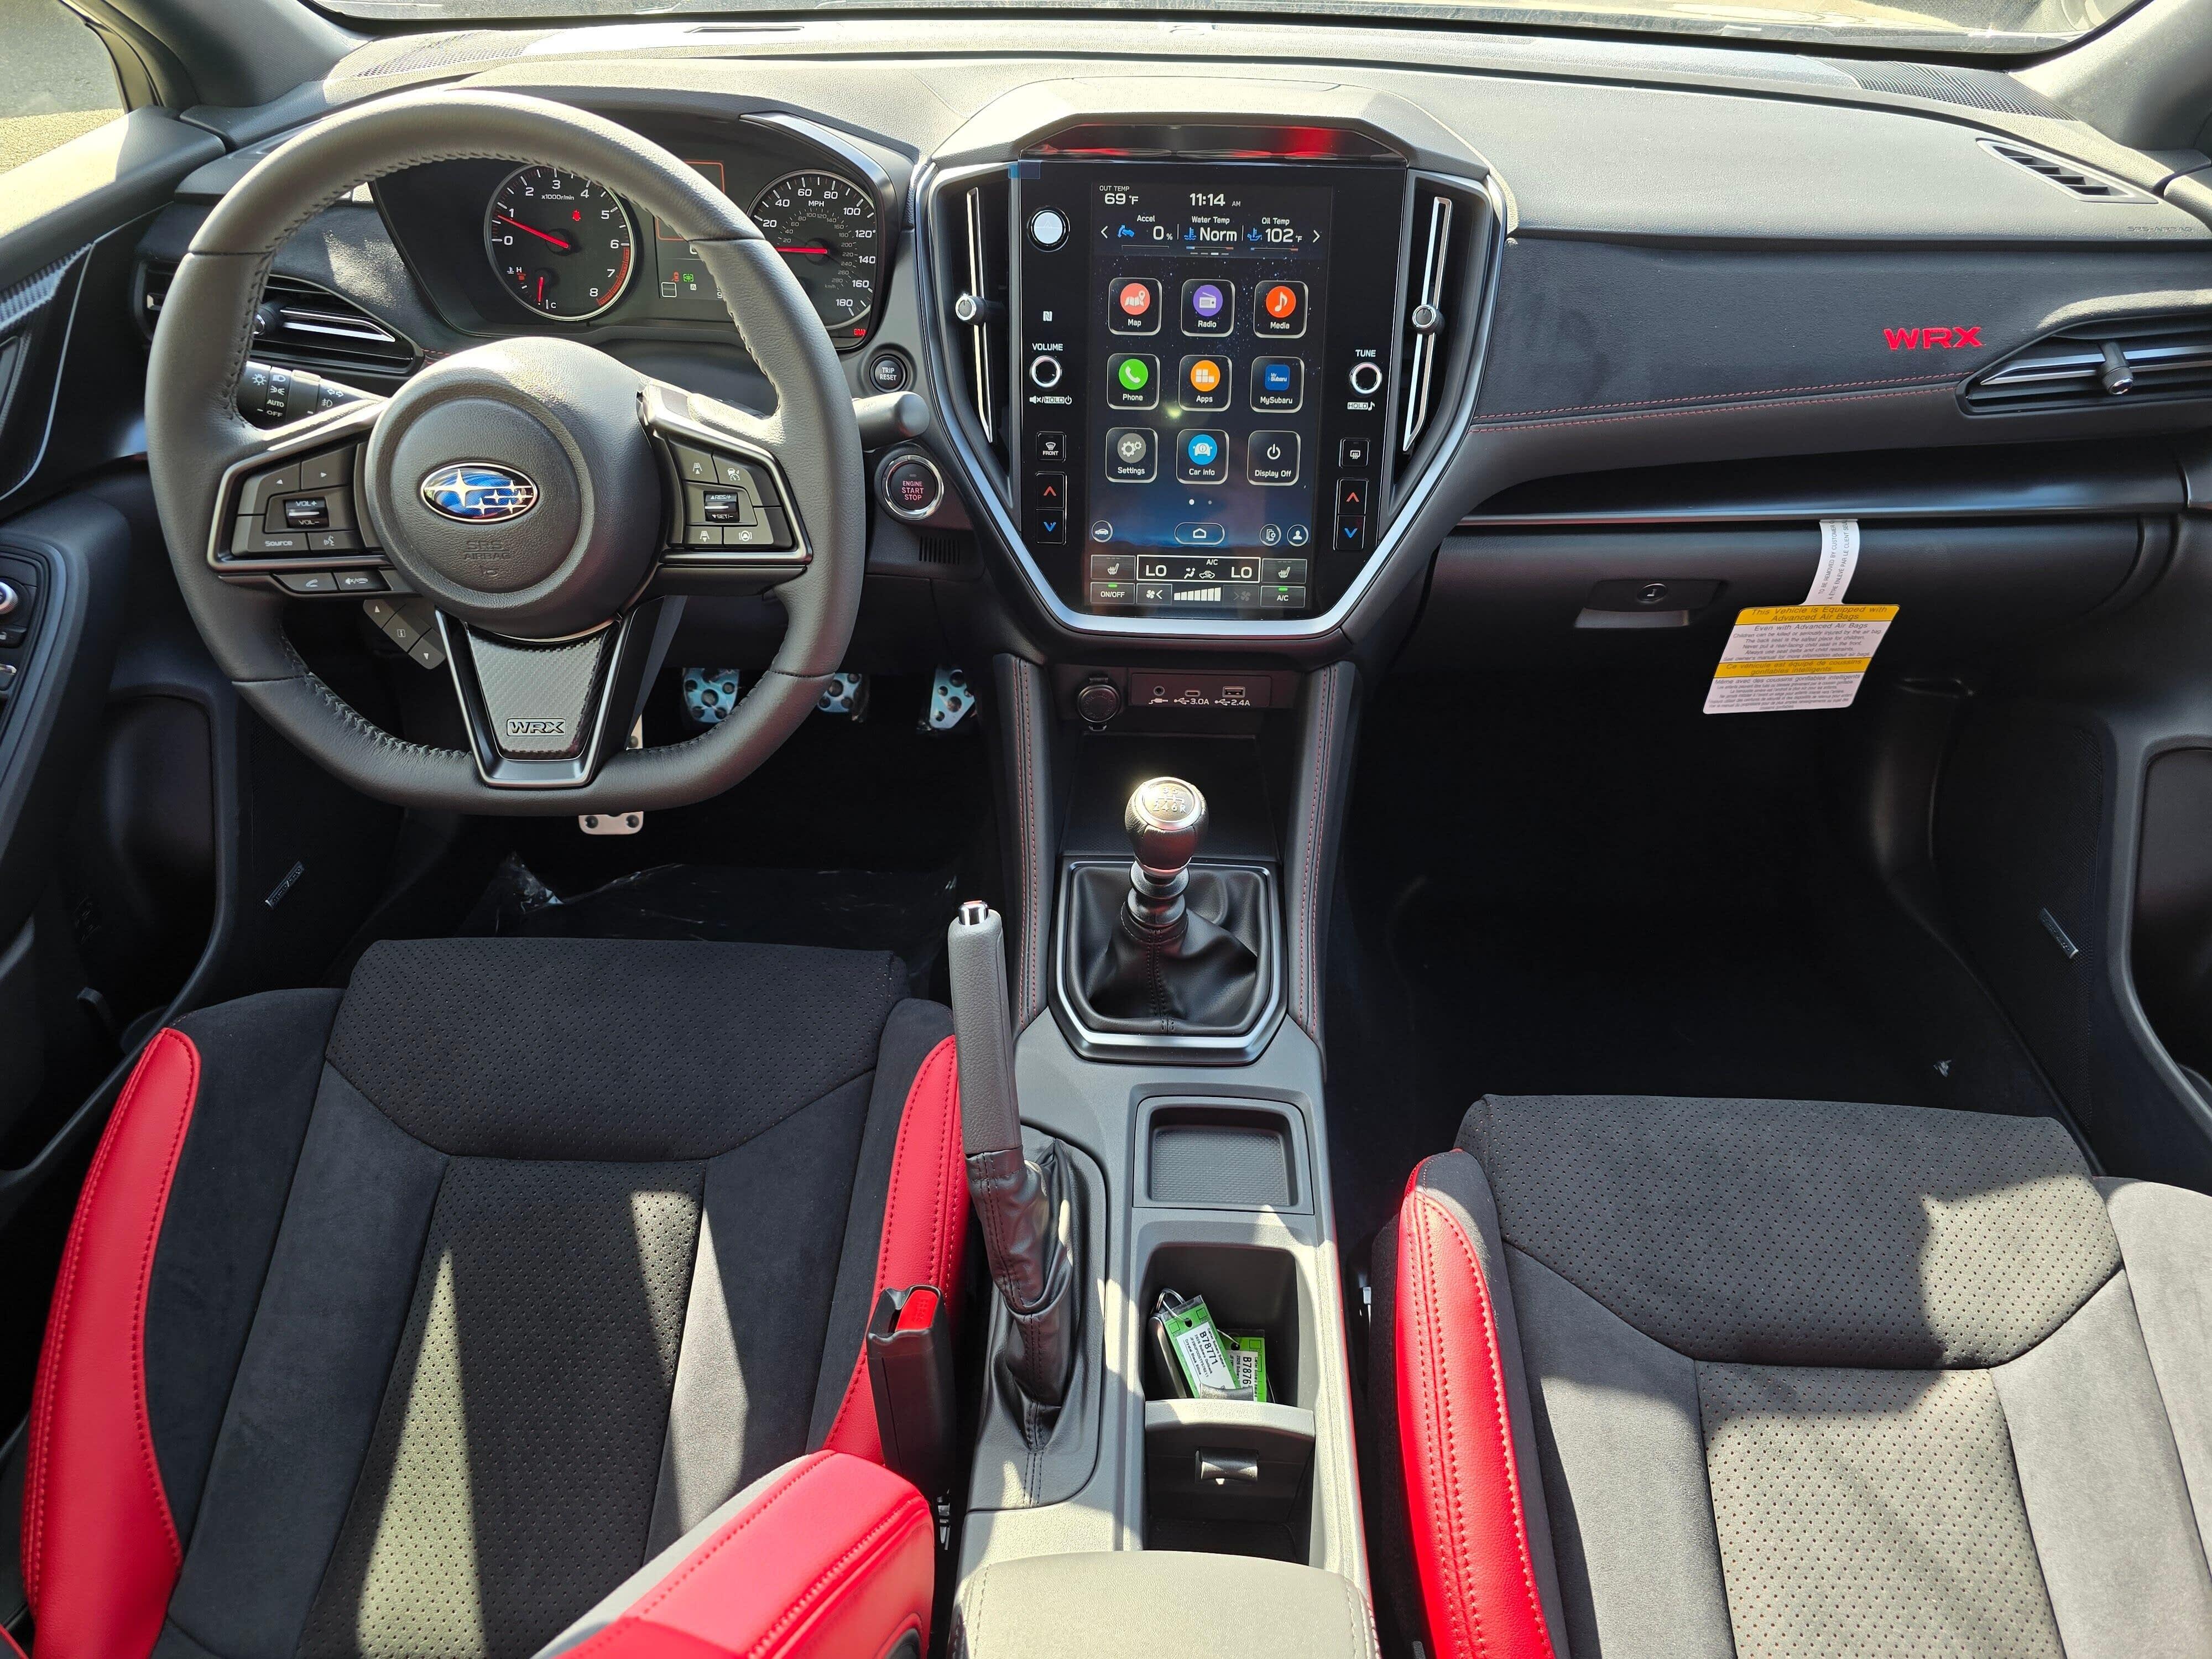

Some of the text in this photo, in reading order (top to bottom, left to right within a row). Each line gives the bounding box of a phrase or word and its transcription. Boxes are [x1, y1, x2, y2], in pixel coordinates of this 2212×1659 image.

[552, 180, 561, 189] 3
[525, 187, 534, 196] 2
[581, 189, 589, 198] 4
[798, 189, 812, 197] 60
[823, 191, 838, 200] 80
[1104, 193, 1126, 205] 69
[1190, 193, 1226, 206] 11:14
[509, 208, 514, 217] 1
[601, 210, 609, 219] 5
[763, 220, 777, 228] 20
[1213, 217, 1230, 225] Temp
[1153, 226, 1164, 240] 0
[1199, 227, 1237, 241] Norm
[1265, 228, 1294, 242] 102
[504, 236, 513, 245] 0
[610, 240, 619, 249] 6
[607, 269, 615, 278] 7
[852, 280, 869, 288] 160
[589, 288, 598, 297] 8
[836, 299, 853, 307] 180
[1884, 326, 1983, 351] WRX
[267, 399, 284, 408] AUTO
[1260, 397, 1293, 405] MySubaru
[1118, 467, 1145, 476] Settings
[1146, 565, 1167, 577] LO
[1231, 566, 1252, 578] LO
[1822, 606, 1866, 614] Equipped
[509, 721, 565, 734] WRX
[1199, 1331, 1219, 1365] B78771
[1243, 1357, 1252, 1386] B7876
